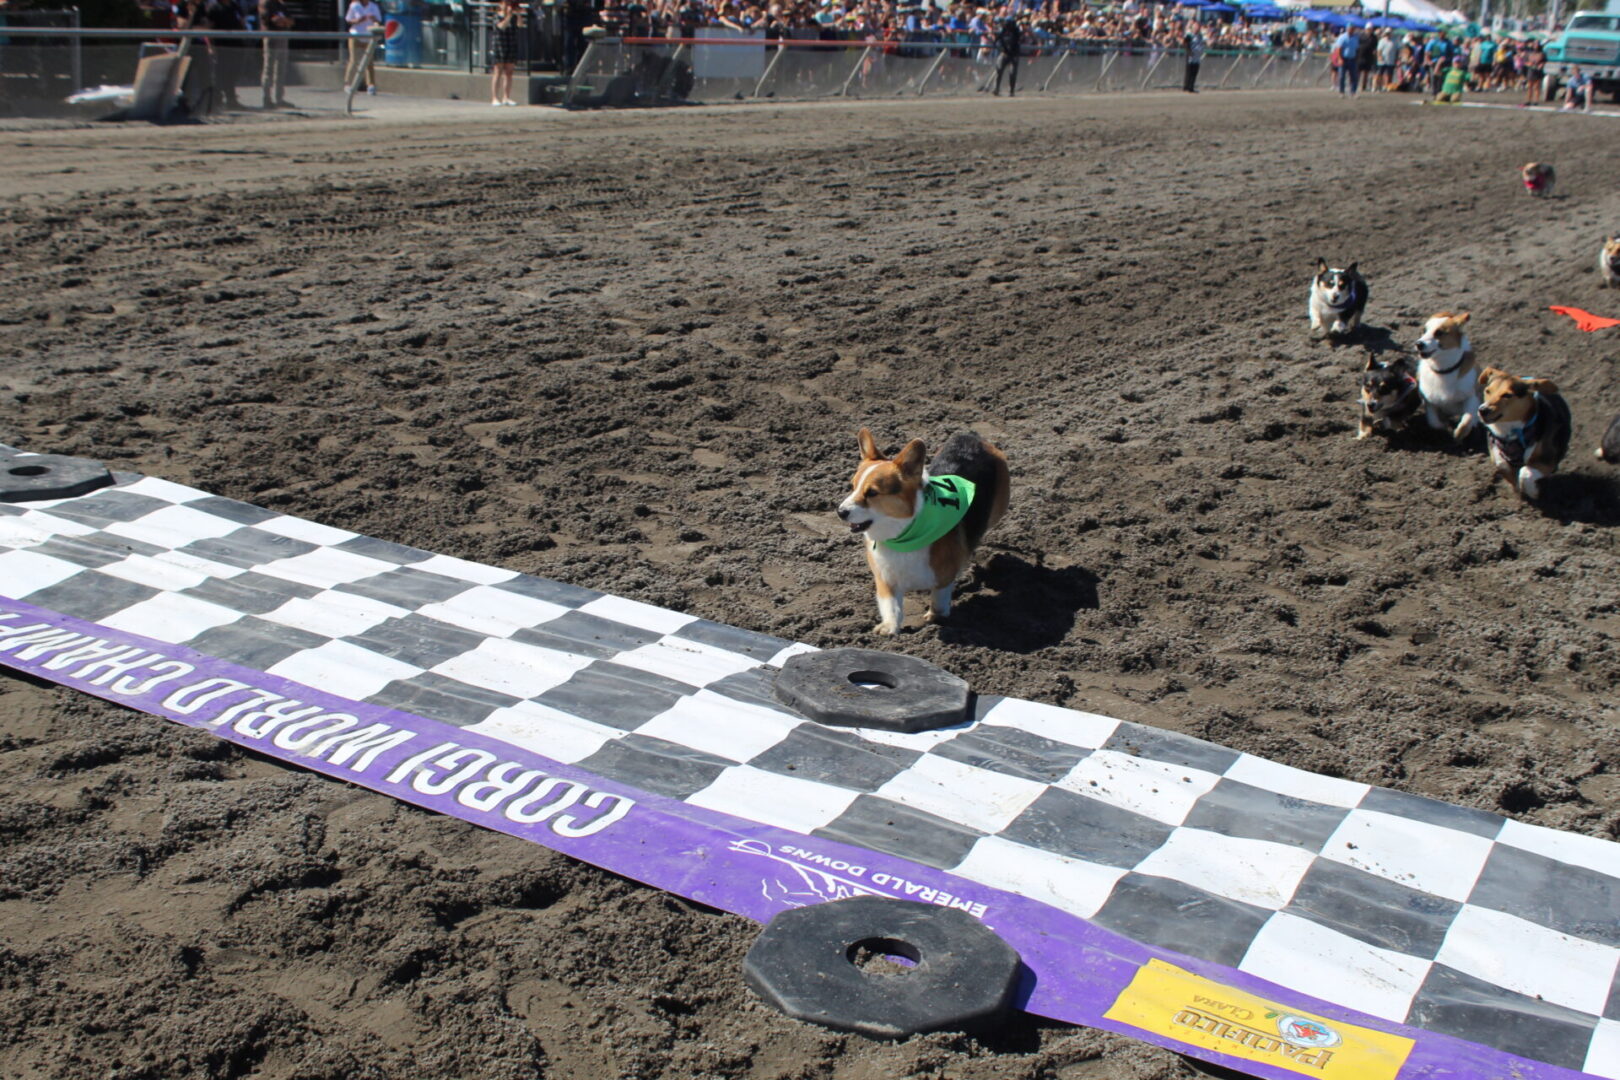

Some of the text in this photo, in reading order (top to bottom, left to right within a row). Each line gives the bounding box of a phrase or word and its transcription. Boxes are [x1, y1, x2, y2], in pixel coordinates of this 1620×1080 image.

[161, 677, 419, 774] WORLD
[385, 742, 637, 839] CORGI
[779, 844, 989, 920] EMERALD DOWNS
[1171, 1009, 1335, 1070] PACIFICO
